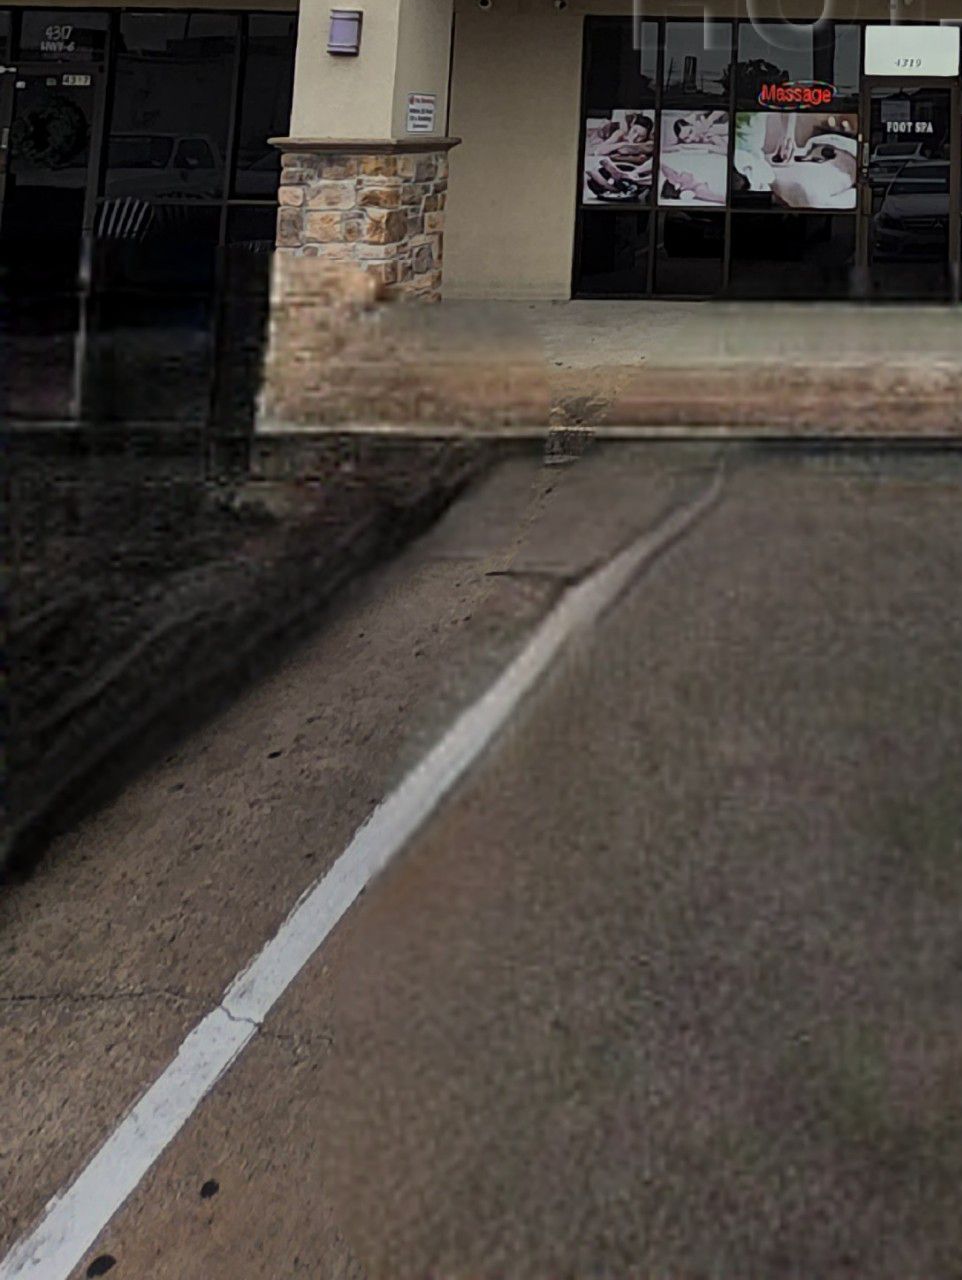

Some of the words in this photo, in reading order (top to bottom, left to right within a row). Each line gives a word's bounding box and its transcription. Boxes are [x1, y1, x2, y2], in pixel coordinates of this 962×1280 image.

[761, 84, 831, 105] Massage
[886, 122, 913, 133] FOOT
[915, 122, 934, 133] SPA
